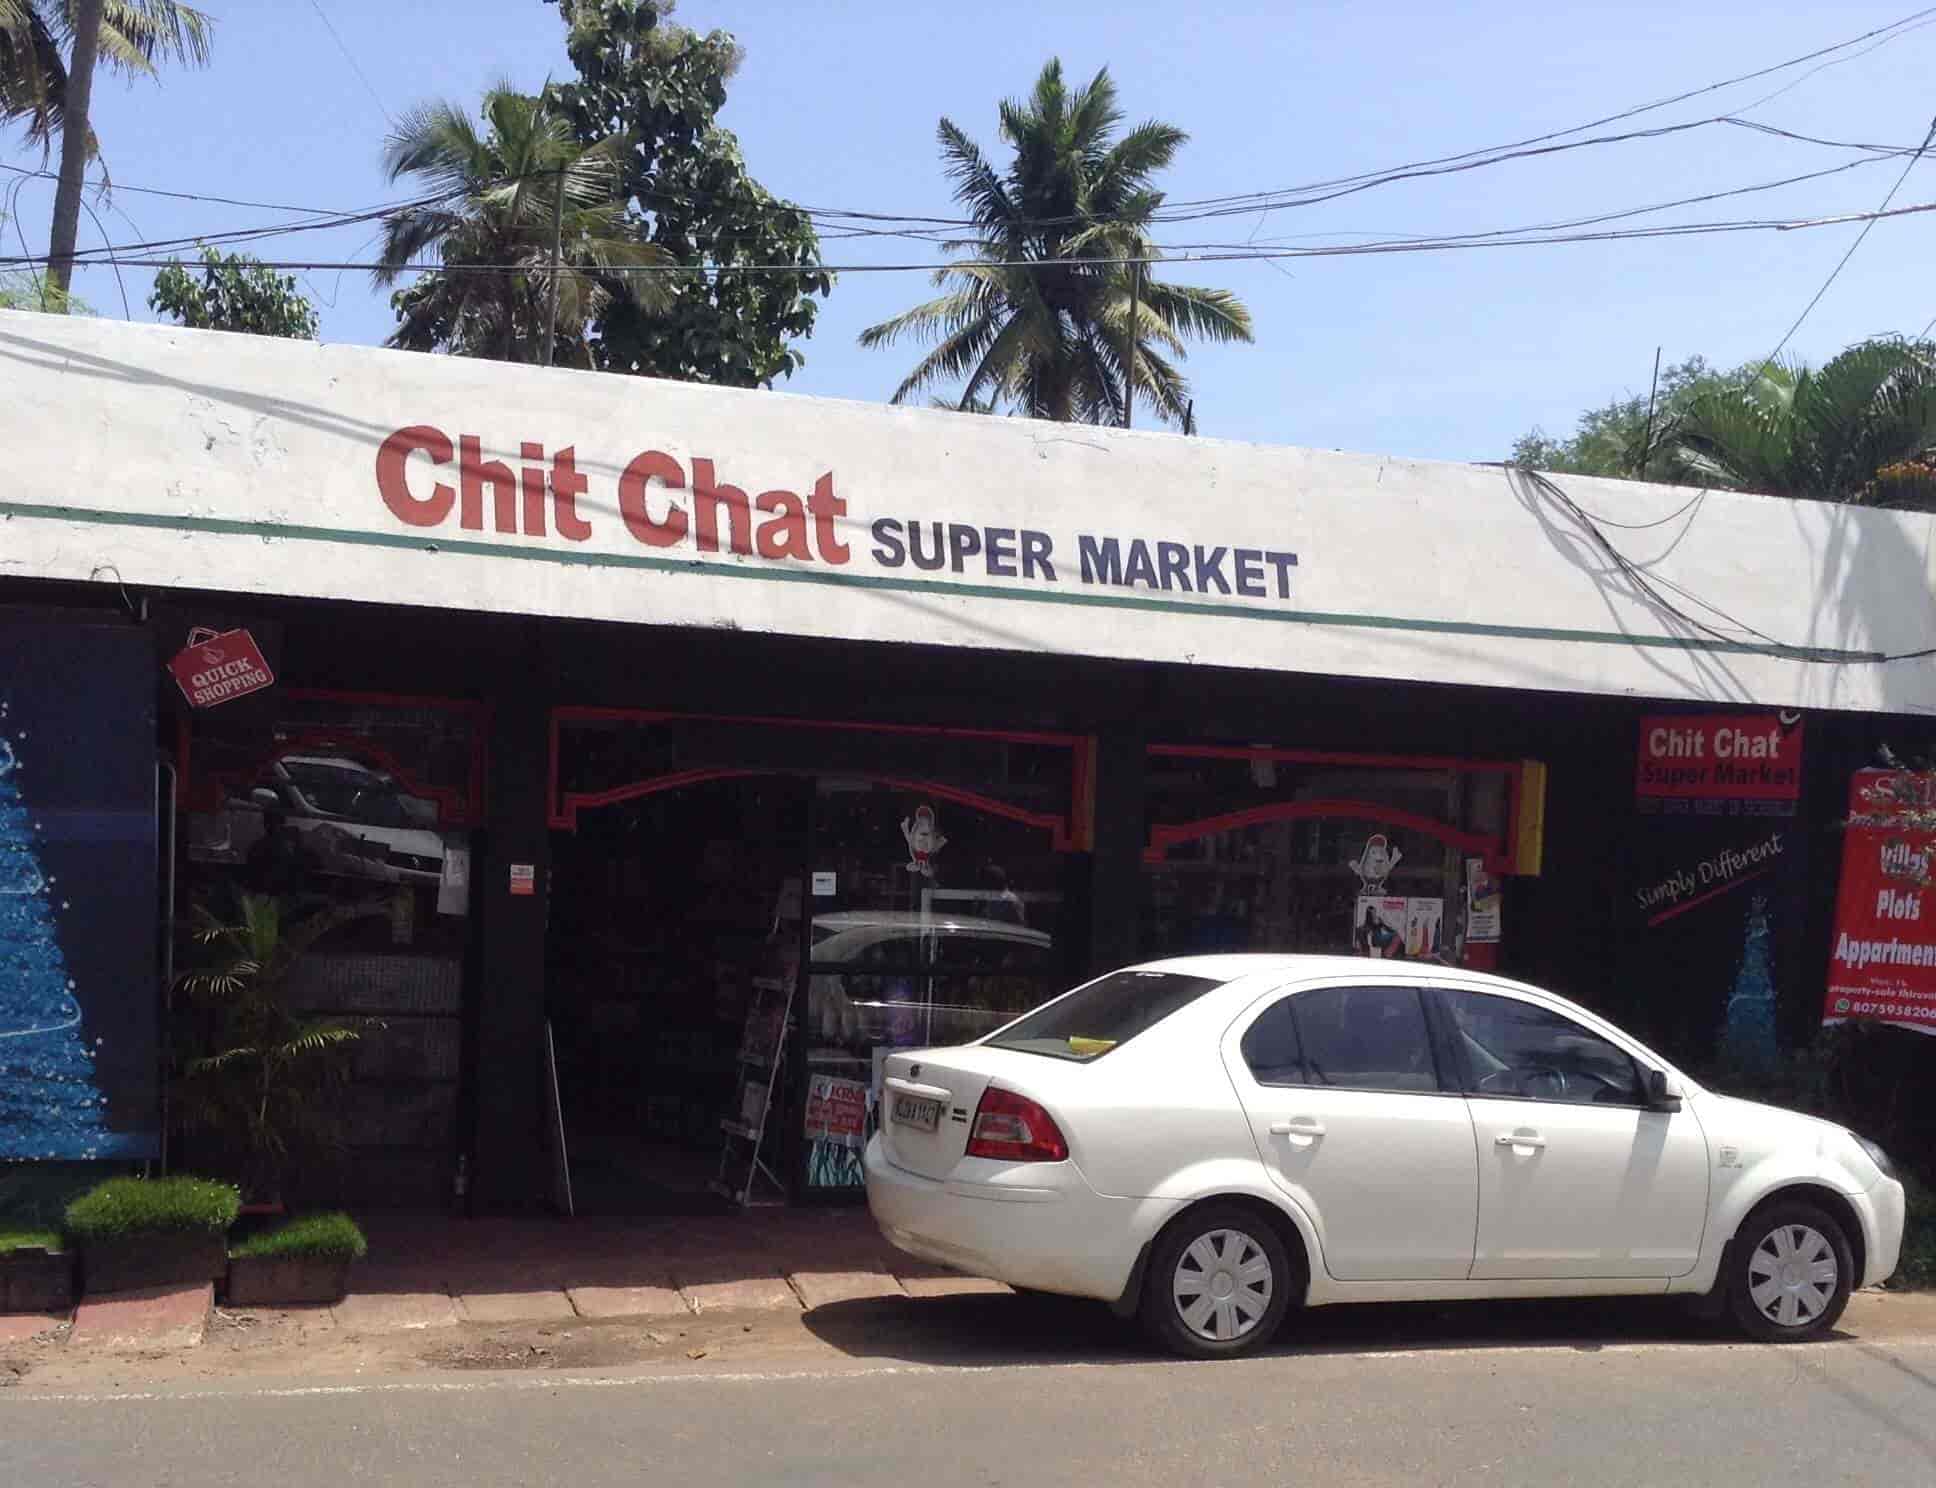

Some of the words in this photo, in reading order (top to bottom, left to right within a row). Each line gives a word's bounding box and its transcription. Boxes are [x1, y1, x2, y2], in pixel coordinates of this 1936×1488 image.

[376, 424, 593, 542] Chit
[618, 449, 850, 565] Chat
[871, 517, 1058, 582] SUPER
[1078, 534, 1299, 600] MARKET
[192, 657, 254, 688] QUICK
[193, 668, 267, 705] SHOPPING
[1648, 727, 1705, 759] Chit
[1713, 727, 1783, 760] Chat
[1640, 762, 1707, 788] Super
[1633, 868, 1697, 911] Simply
[1697, 832, 1785, 883] Different
[1876, 889, 1921, 920] Plots
